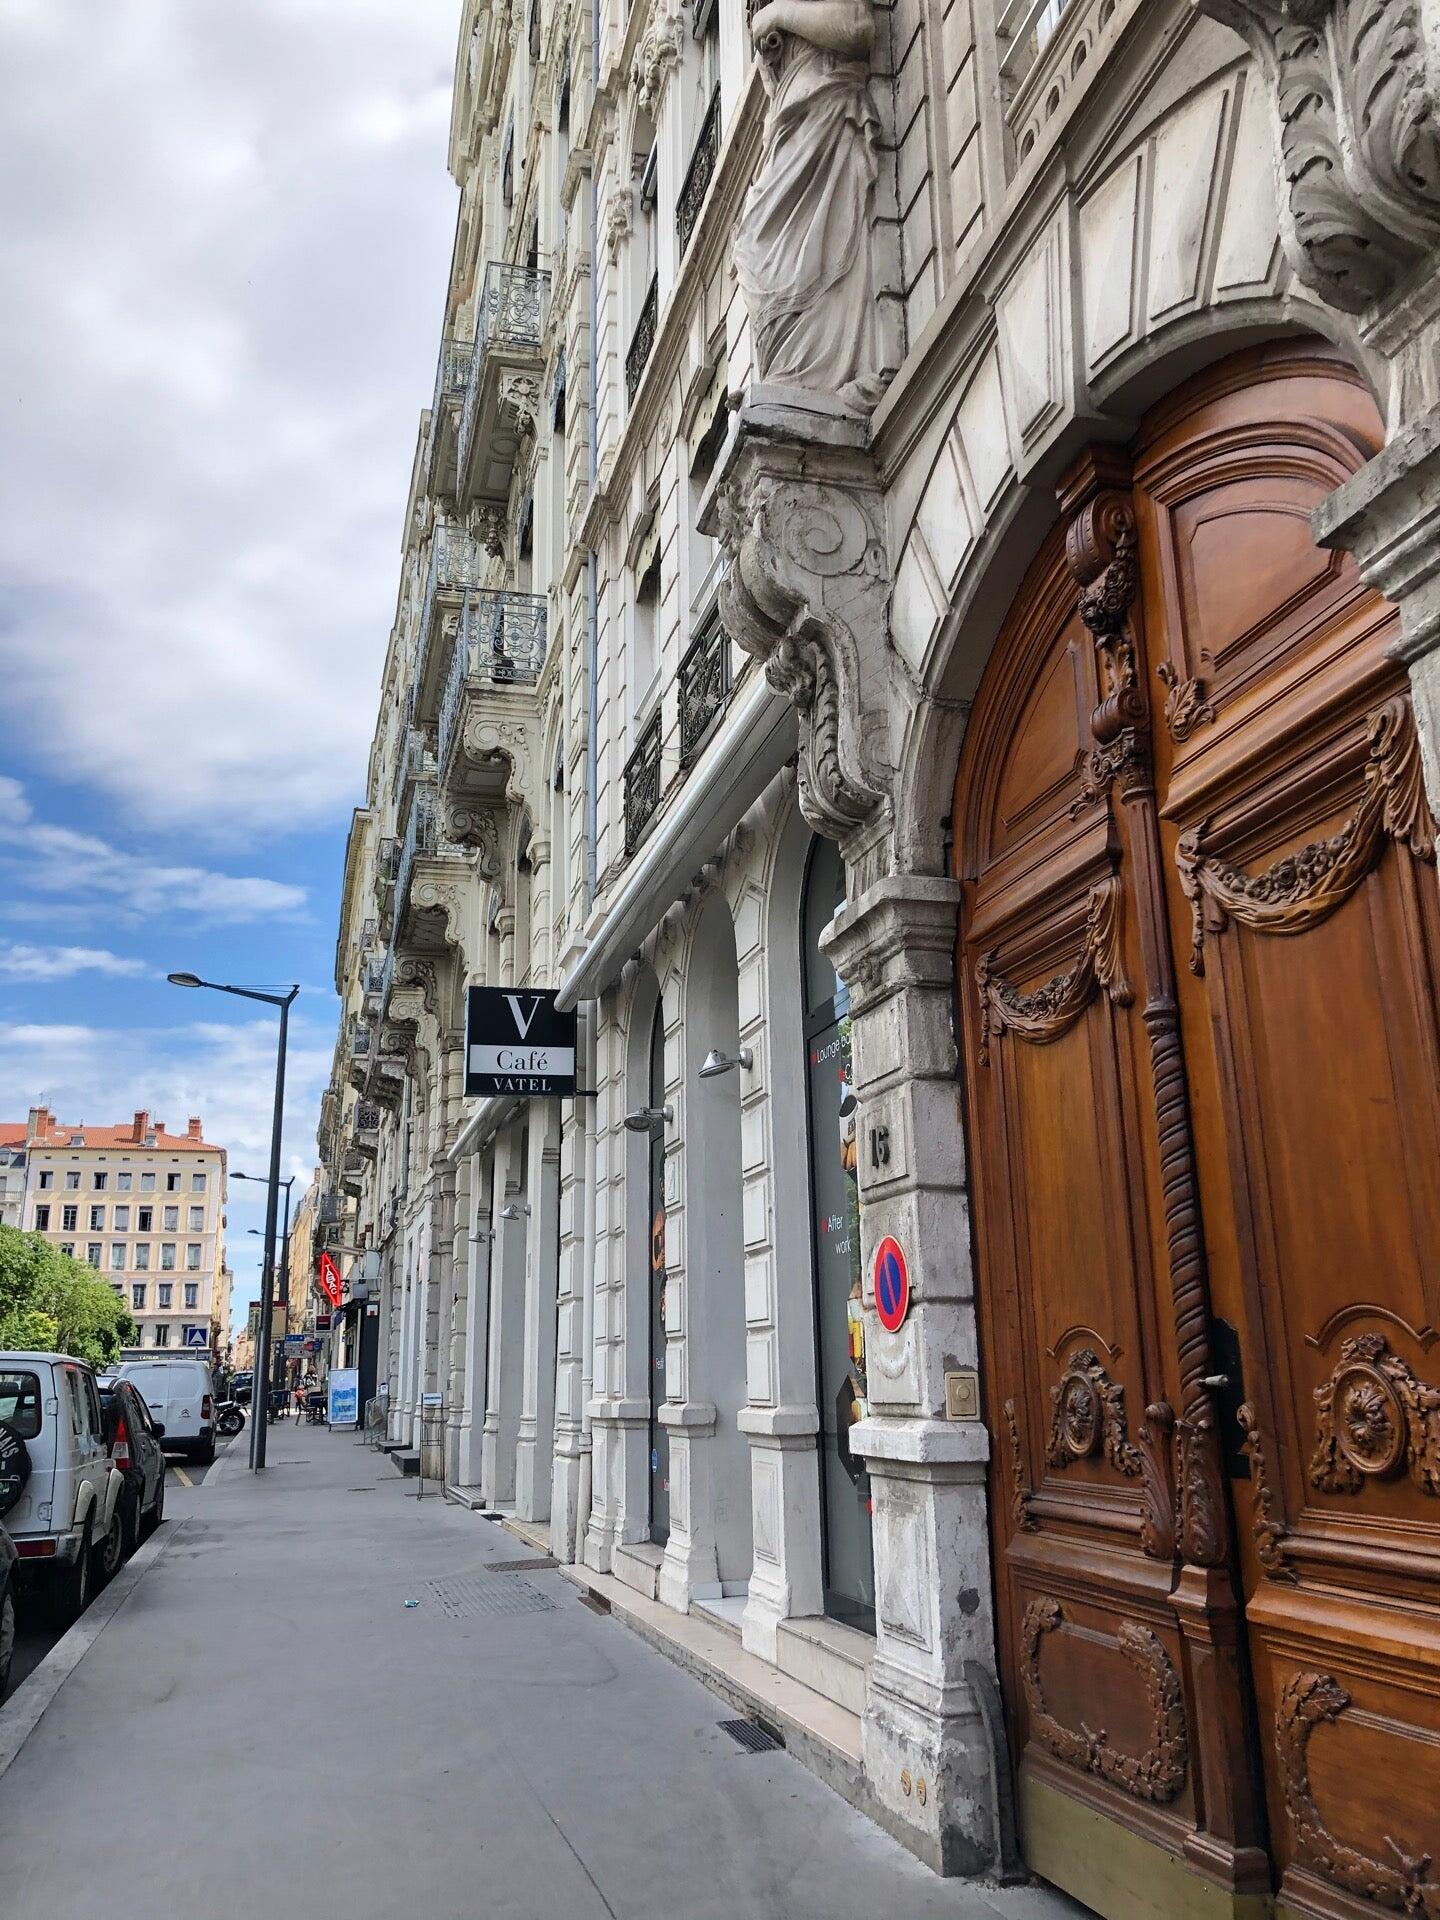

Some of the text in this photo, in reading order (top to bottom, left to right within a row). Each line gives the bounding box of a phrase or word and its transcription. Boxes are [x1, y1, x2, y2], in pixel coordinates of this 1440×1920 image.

[502, 994, 546, 1040] V
[496, 1050, 548, 1071] Café
[816, 1039, 840, 1063] Lounge
[493, 1077, 551, 1091] VATEL
[869, 1125, 890, 1169] 16
[827, 1214, 844, 1232] After
[834, 1236, 852, 1254] work
[325, 1264, 338, 1295] TABAC
